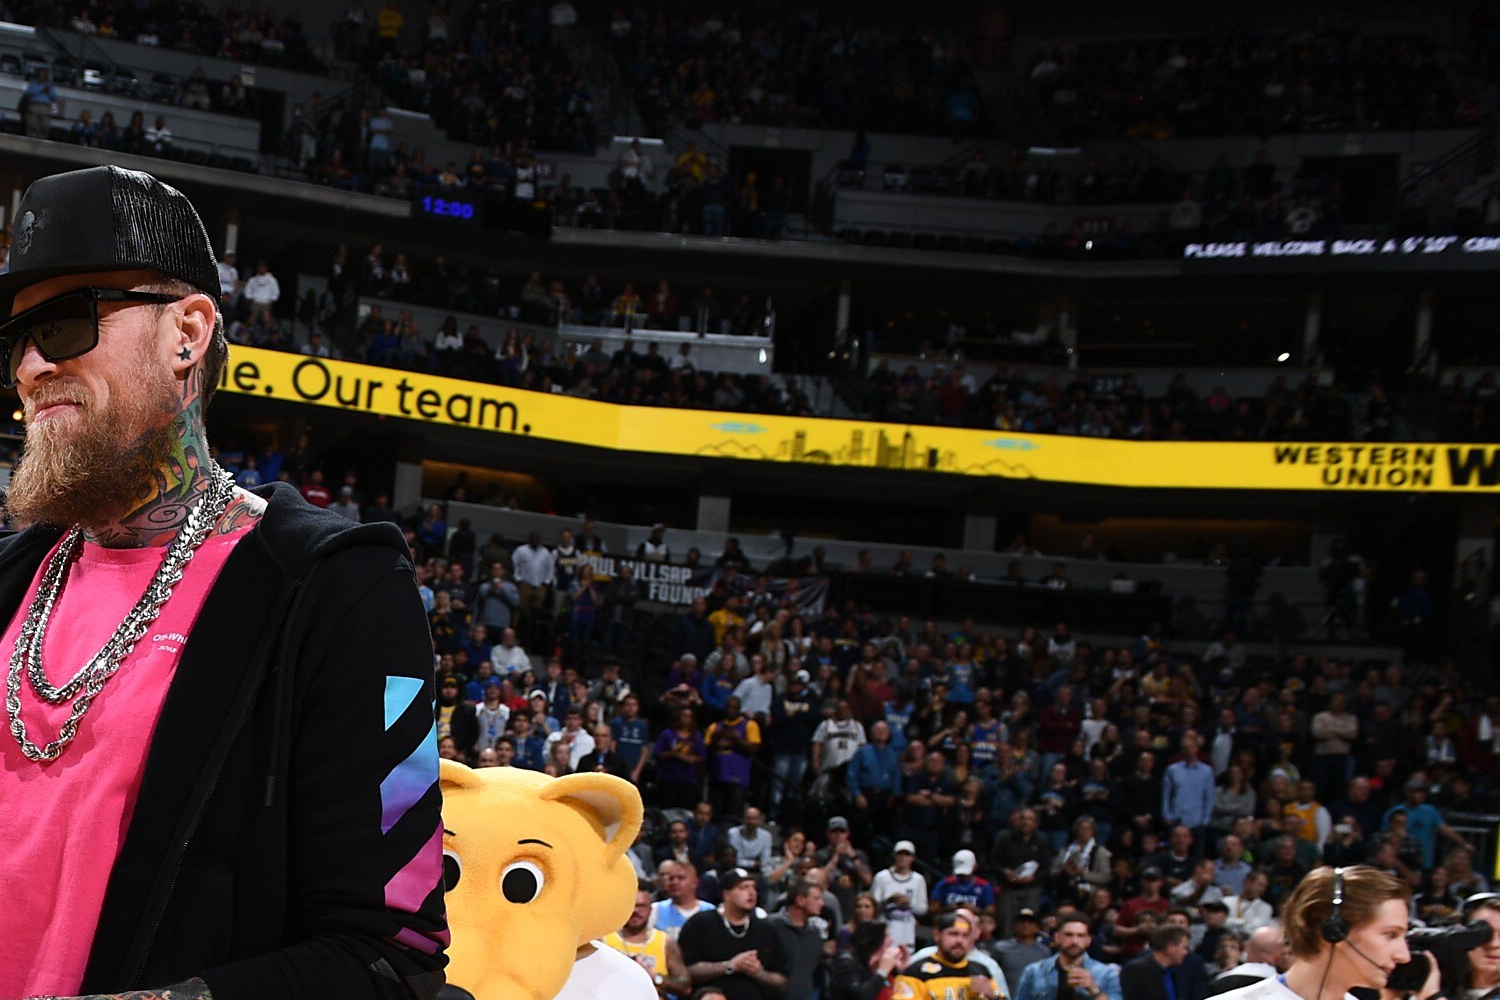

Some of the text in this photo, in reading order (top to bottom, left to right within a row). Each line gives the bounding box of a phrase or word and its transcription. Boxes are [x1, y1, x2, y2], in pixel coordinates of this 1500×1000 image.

[422, 196, 474, 219] 12:00
[292, 358, 382, 410] Our
[396, 378, 531, 433] team.
[1273, 446, 1435, 466] WESTERN
[1321, 447, 1500, 487] UNION W
